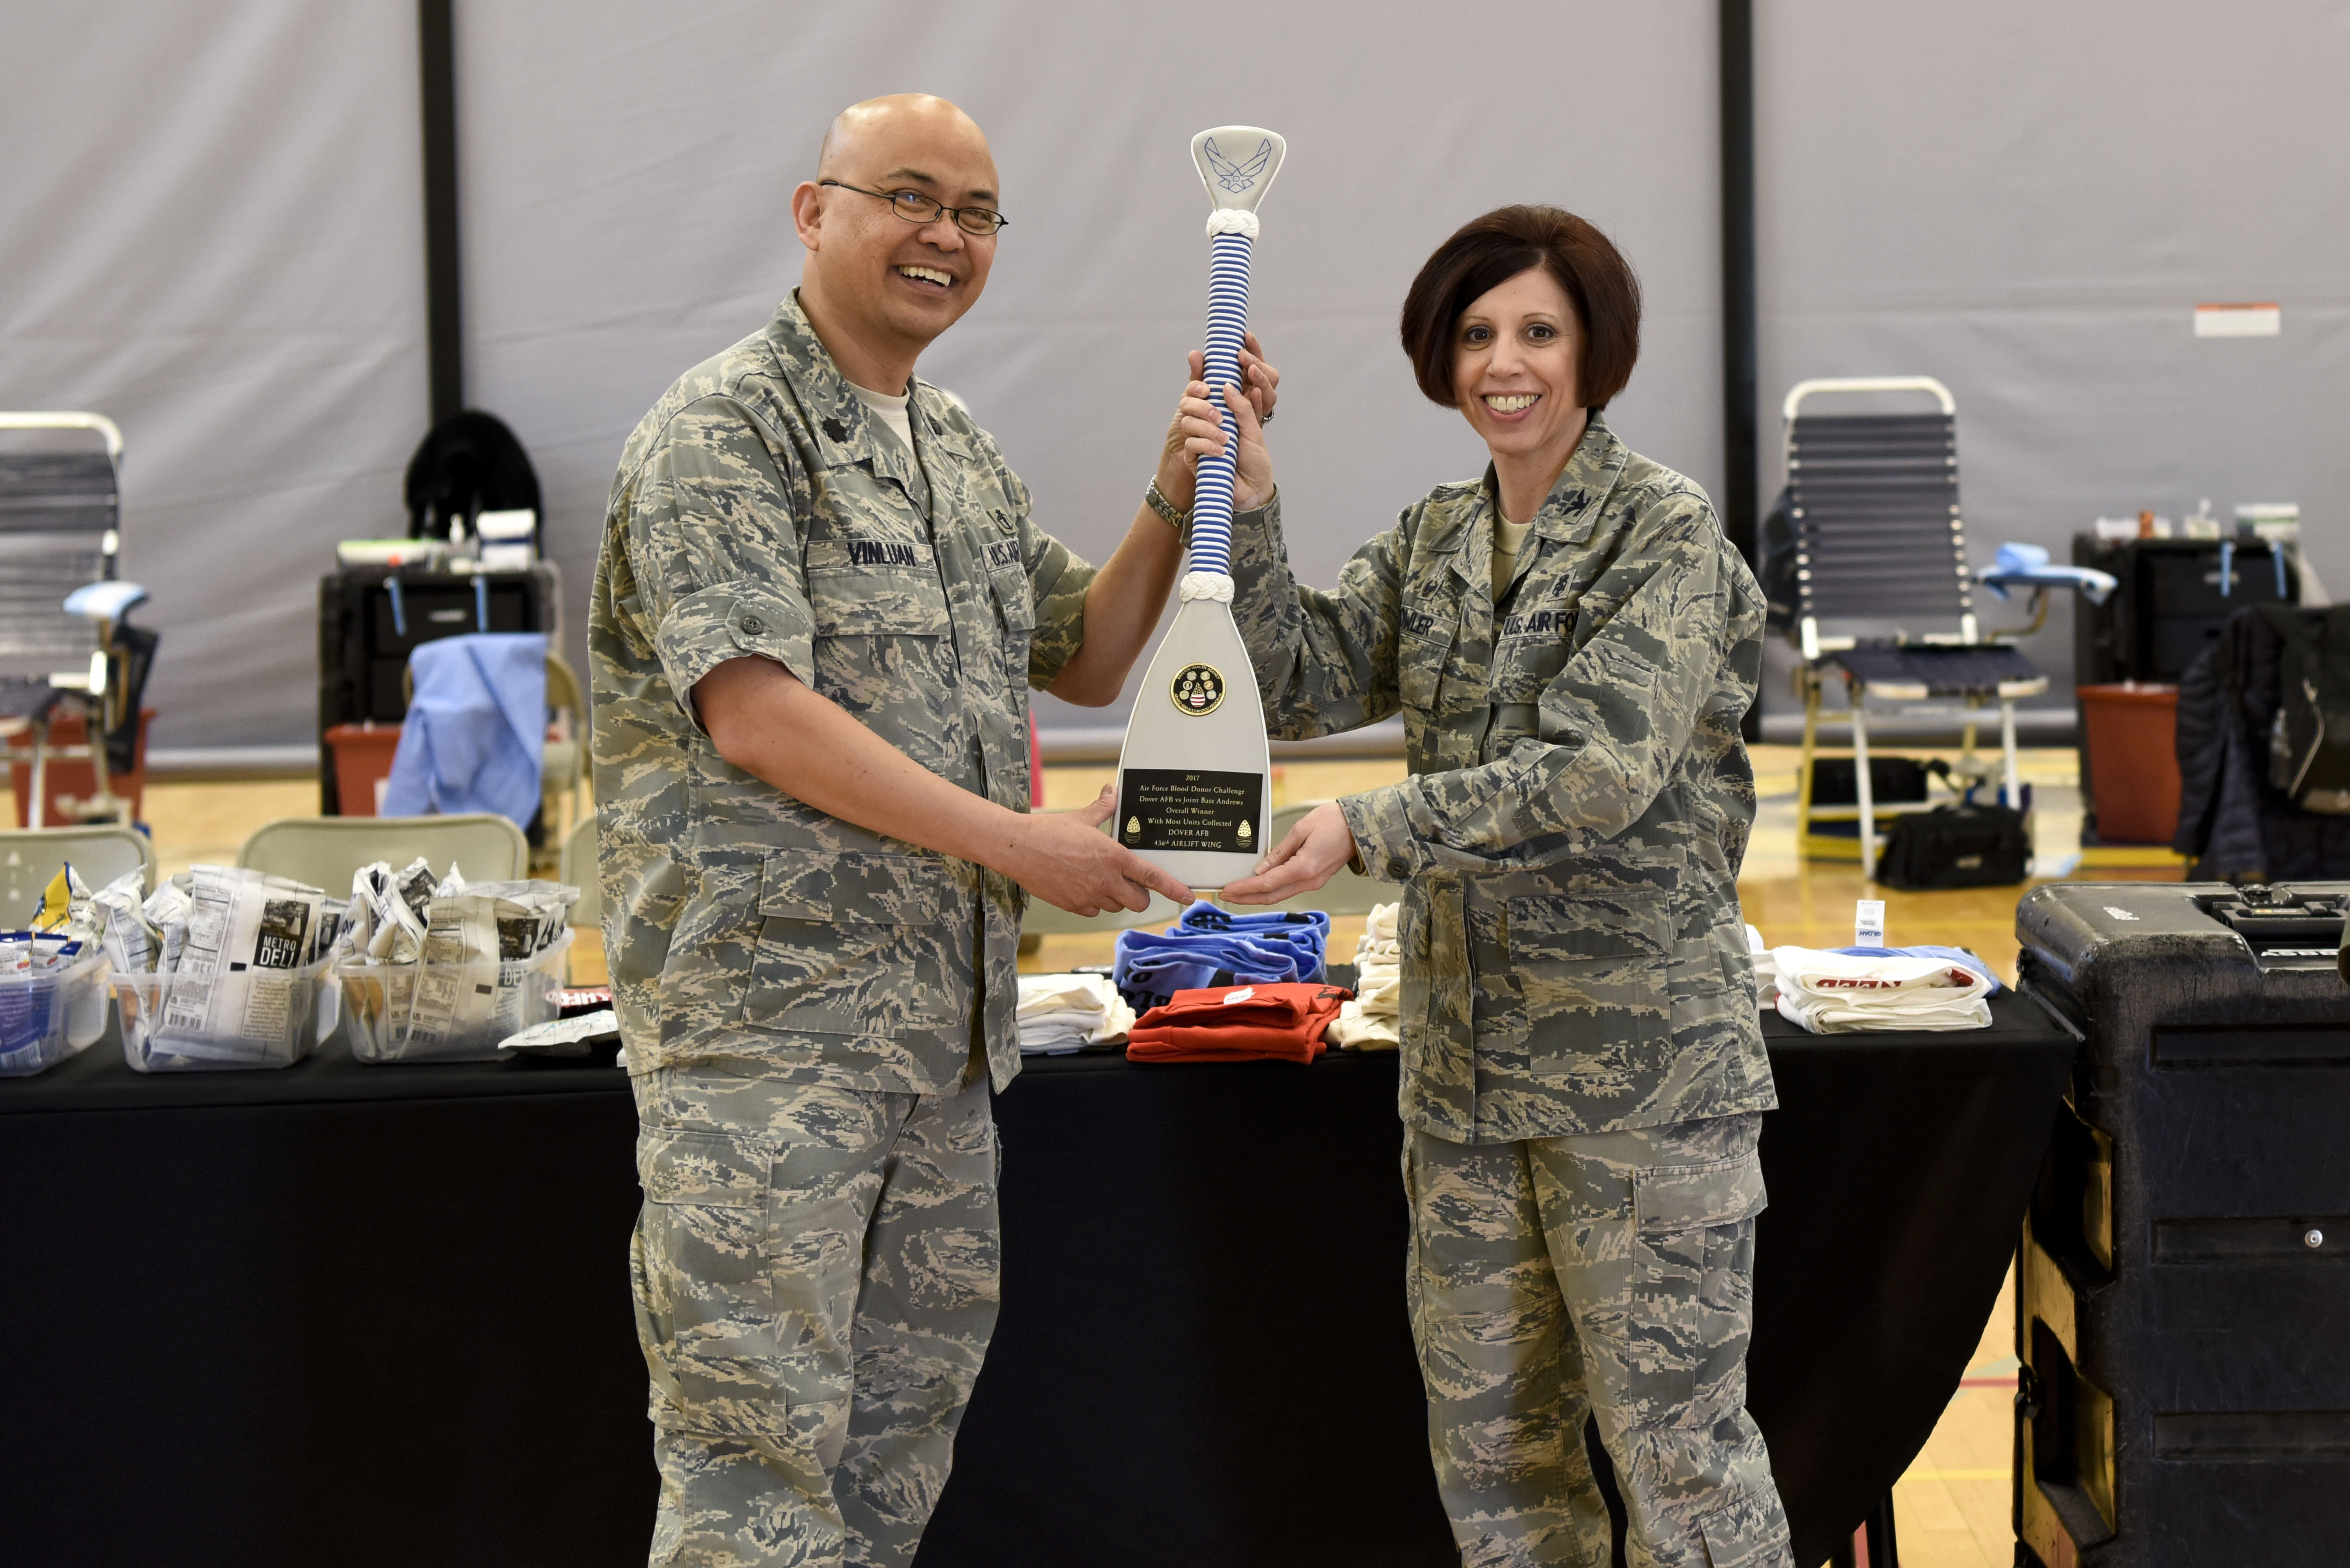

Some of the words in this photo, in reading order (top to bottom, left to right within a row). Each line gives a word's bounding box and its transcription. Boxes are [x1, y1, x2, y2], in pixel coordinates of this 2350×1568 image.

[847, 542, 916, 566] VINLUAN
[988, 543, 1009, 566] U.S.
[1504, 617, 1523, 636] U.S.
[1525, 611, 1551, 632] AIR
[1213, 787, 1245, 796] Challenge
[263, 935, 296, 951] METRO
